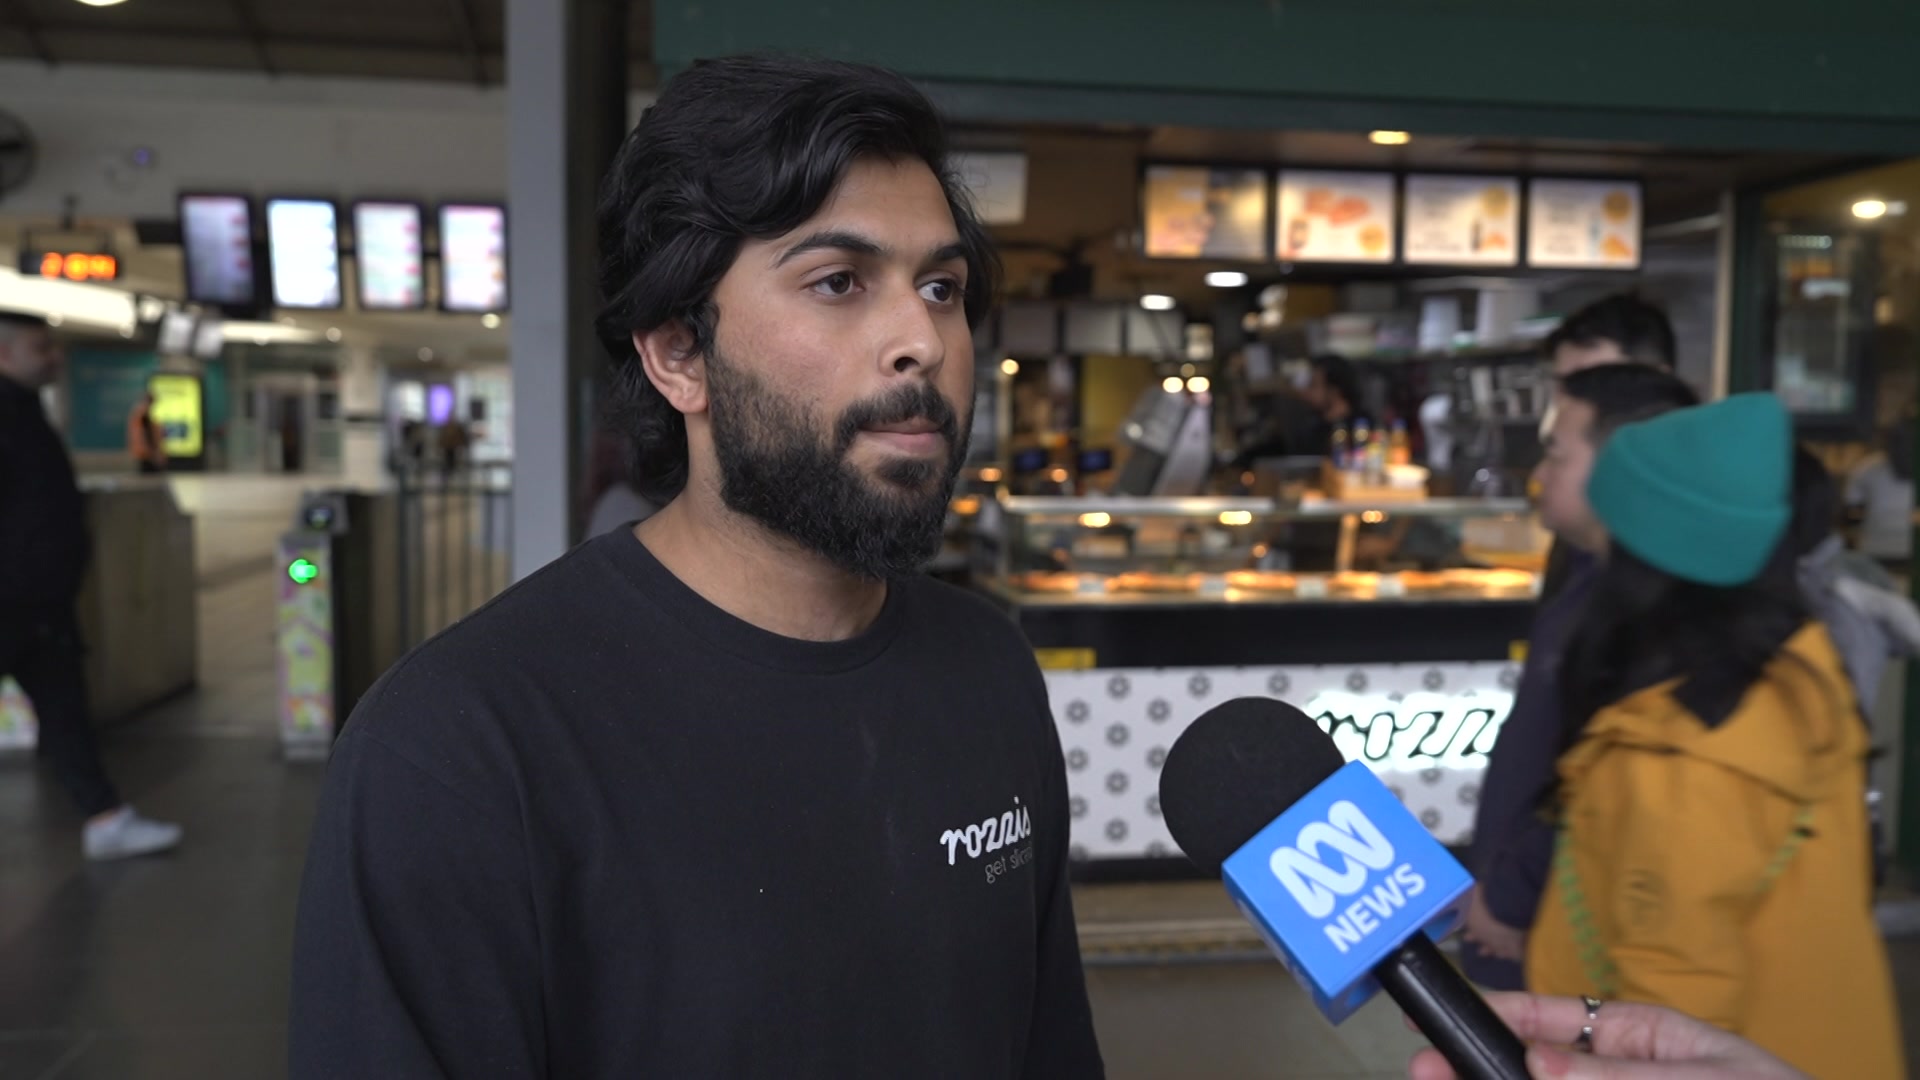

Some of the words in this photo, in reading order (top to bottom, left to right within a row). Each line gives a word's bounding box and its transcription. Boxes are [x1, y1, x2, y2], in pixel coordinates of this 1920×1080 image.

[1312, 704, 1503, 765] rozz
[984, 855, 1008, 885] get
[1323, 862, 1427, 954] NEWS
